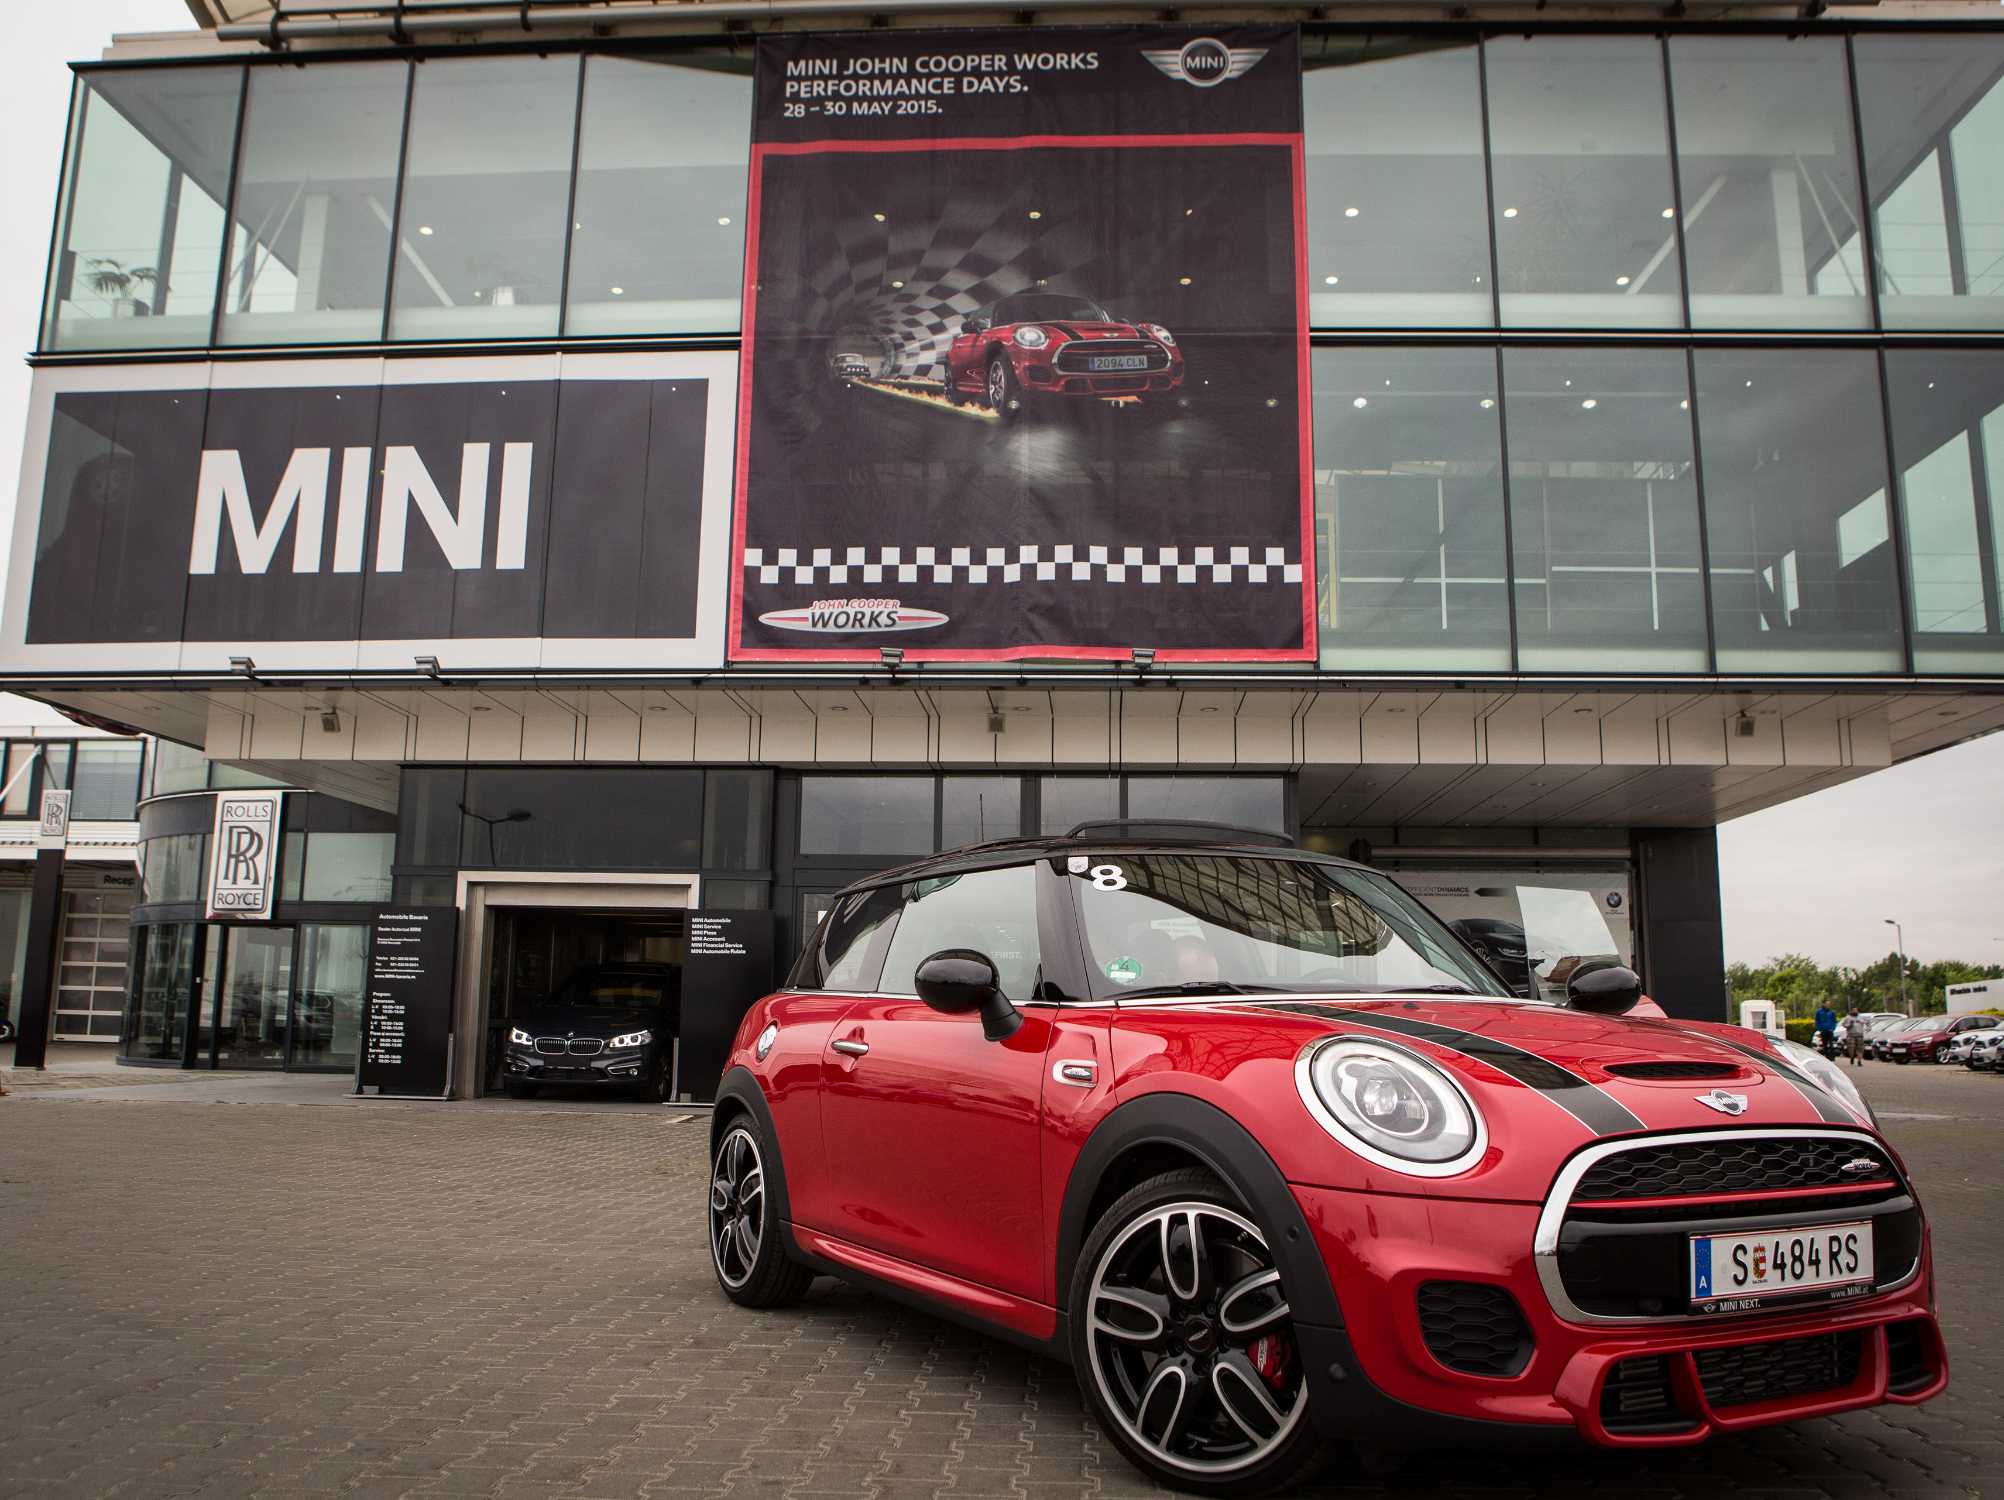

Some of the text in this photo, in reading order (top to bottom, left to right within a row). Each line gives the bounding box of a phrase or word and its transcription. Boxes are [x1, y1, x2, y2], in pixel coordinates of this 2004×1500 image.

[786, 52, 1099, 77] MINI JOHN COOPER WORKS
[1186, 56, 1224, 69] MINI
[785, 75, 1029, 98] PERFORMANCE DAYS.
[783, 103, 806, 118] 28
[824, 101, 847, 116] 30
[852, 101, 893, 115] MAY
[896, 99, 943, 115] 2015.
[1096, 358, 1123, 369] 2094
[189, 442, 533, 574] MINI
[811, 599, 899, 610] JOHN COOPER
[811, 610, 898, 628] WORKS
[225, 804, 269, 818] ROLLS
[217, 892, 261, 906] ROYCE
[1732, 1233, 1859, 1286] S 484 RS
[1699, 1275, 1708, 1289] A
[1719, 1298, 1761, 1313] MINI NEXT.
